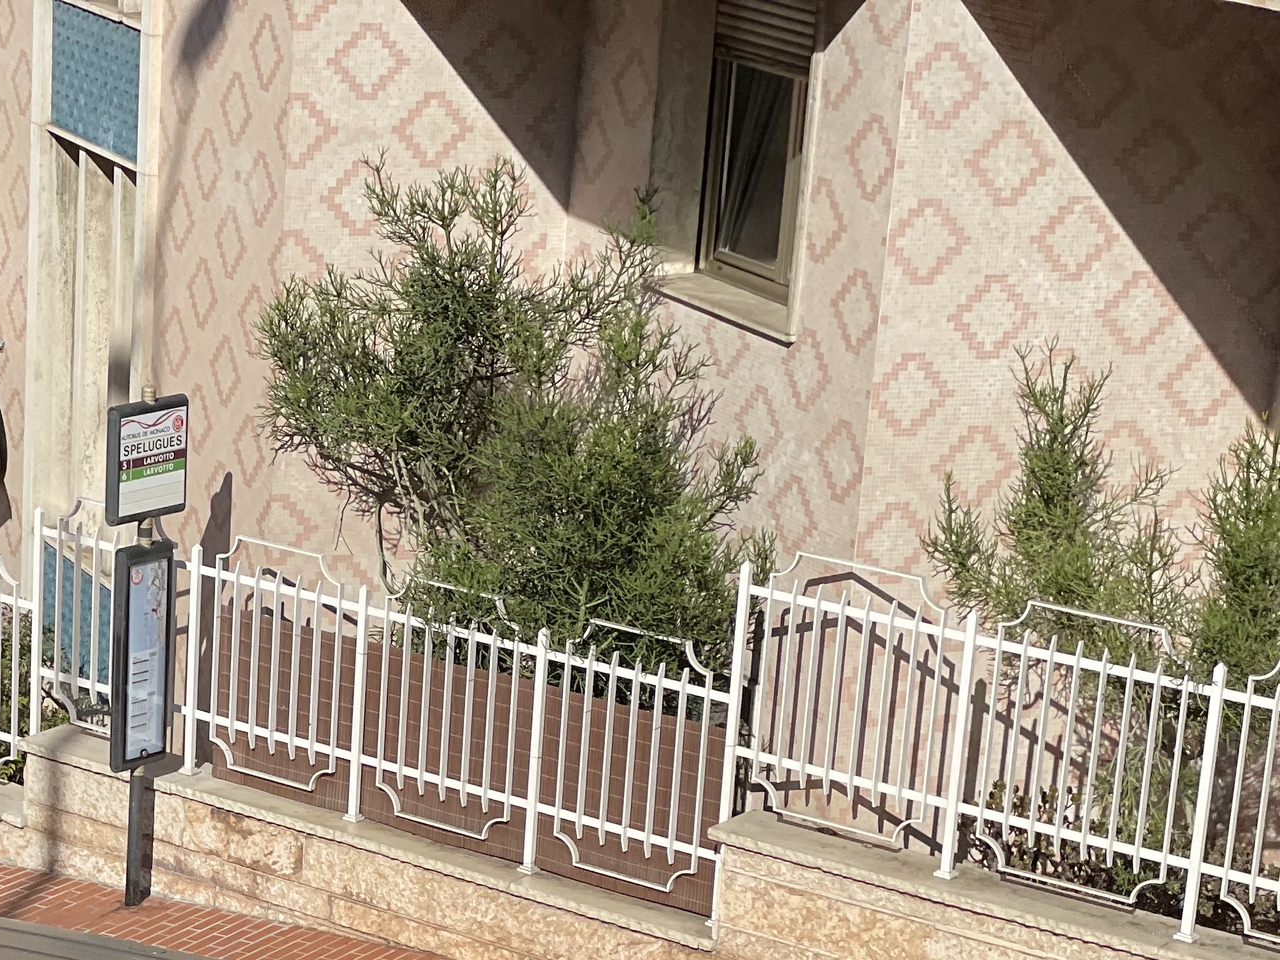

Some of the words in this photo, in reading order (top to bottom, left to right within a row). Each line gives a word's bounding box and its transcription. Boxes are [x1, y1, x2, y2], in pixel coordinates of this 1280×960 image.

[123, 435, 182, 457] SPELUGUES
[122, 461, 127, 470] 5
[144, 452, 174, 465] LARVOTTO
[121, 472, 127, 480] 6
[143, 463, 174, 476] LARVOTTO
